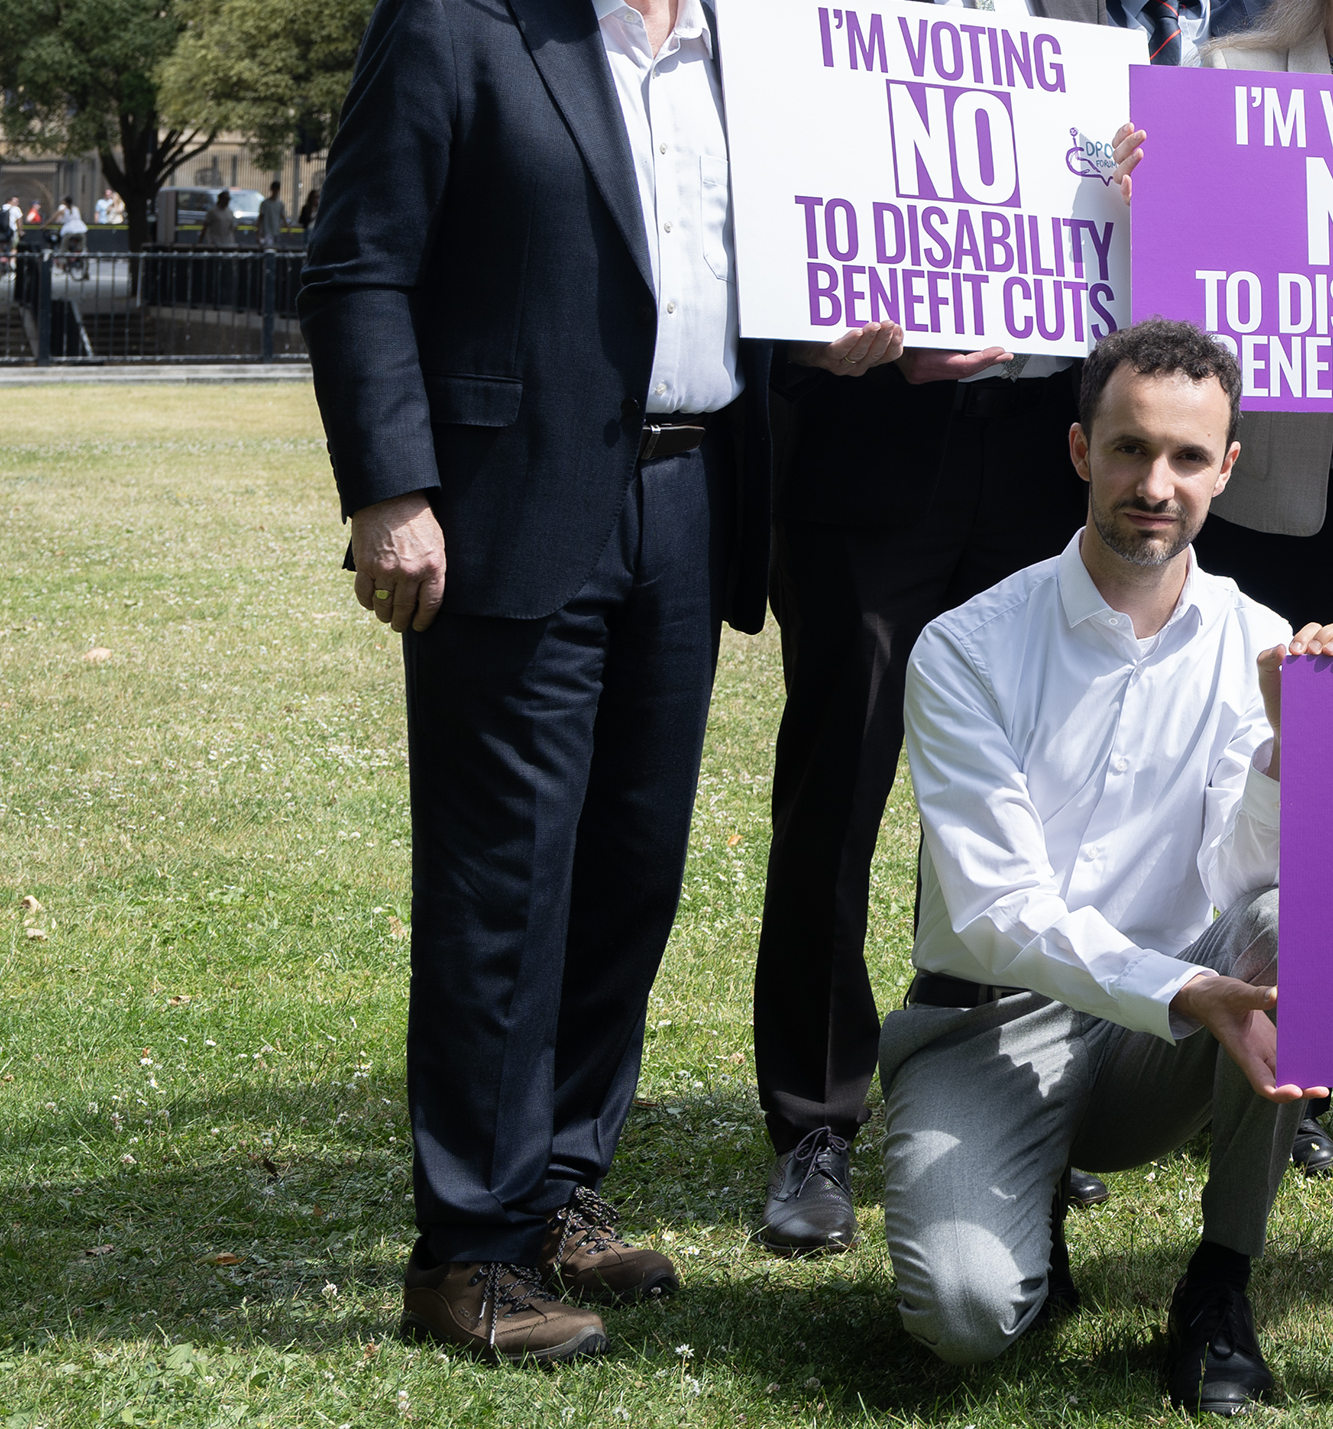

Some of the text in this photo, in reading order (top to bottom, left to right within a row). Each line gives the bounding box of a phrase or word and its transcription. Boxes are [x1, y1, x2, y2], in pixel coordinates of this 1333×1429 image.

[818, 7, 1066, 93] I'M VOTING
[890, 83, 1016, 204] NO
[1086, 141, 1113, 159] DPO
[1235, 85, 1306, 147] I'M
[795, 196, 1114, 281] TO DISABILITY
[807, 262, 1117, 342] BENEFIT CUTS
[1196, 270, 1262, 333] TO
